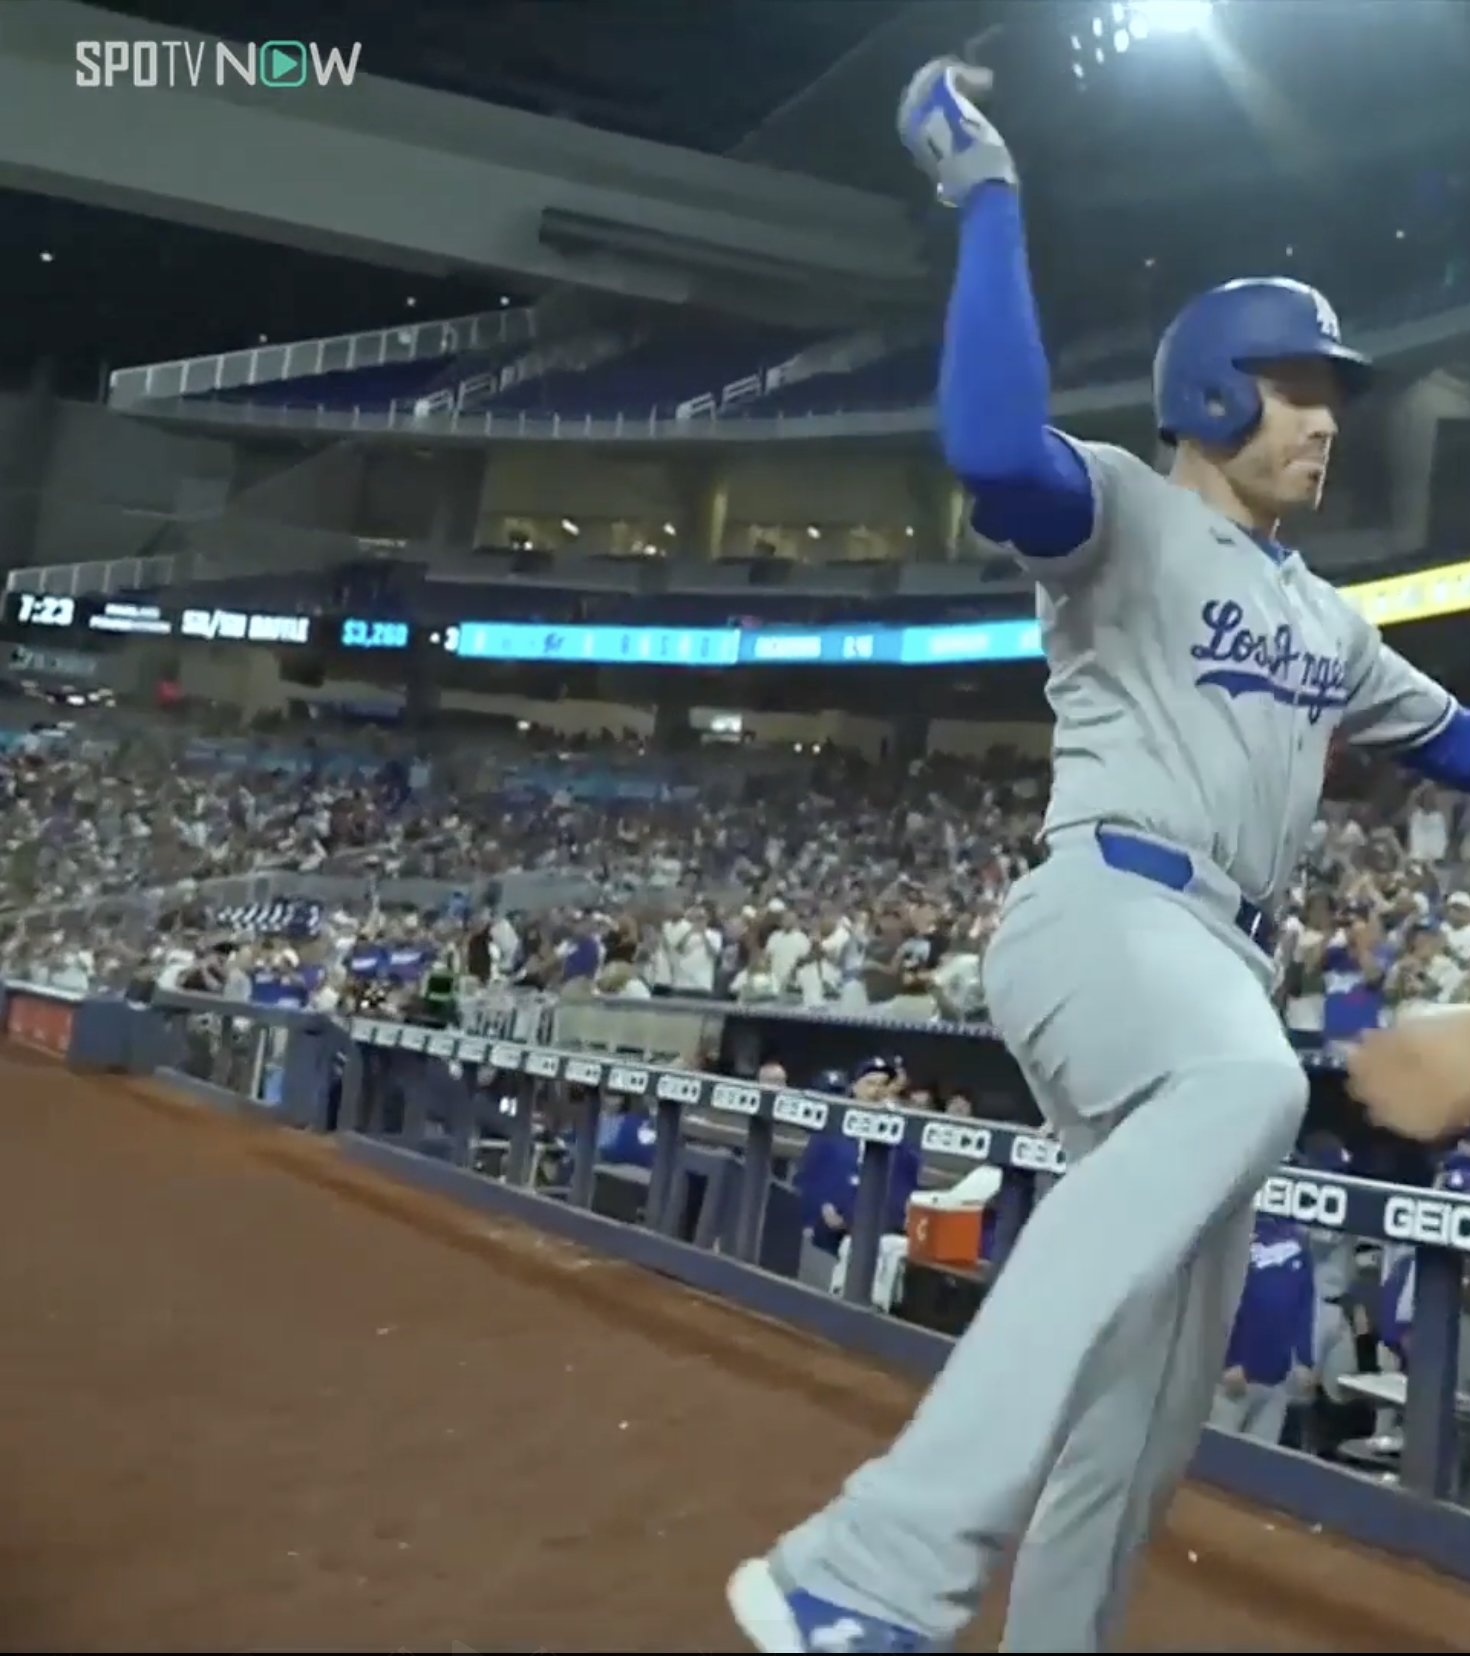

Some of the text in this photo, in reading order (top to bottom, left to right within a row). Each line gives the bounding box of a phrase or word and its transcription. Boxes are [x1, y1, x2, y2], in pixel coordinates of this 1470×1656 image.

[1190, 600, 1345, 725] Los Ange
[922, 1121, 992, 1159] GEICO
